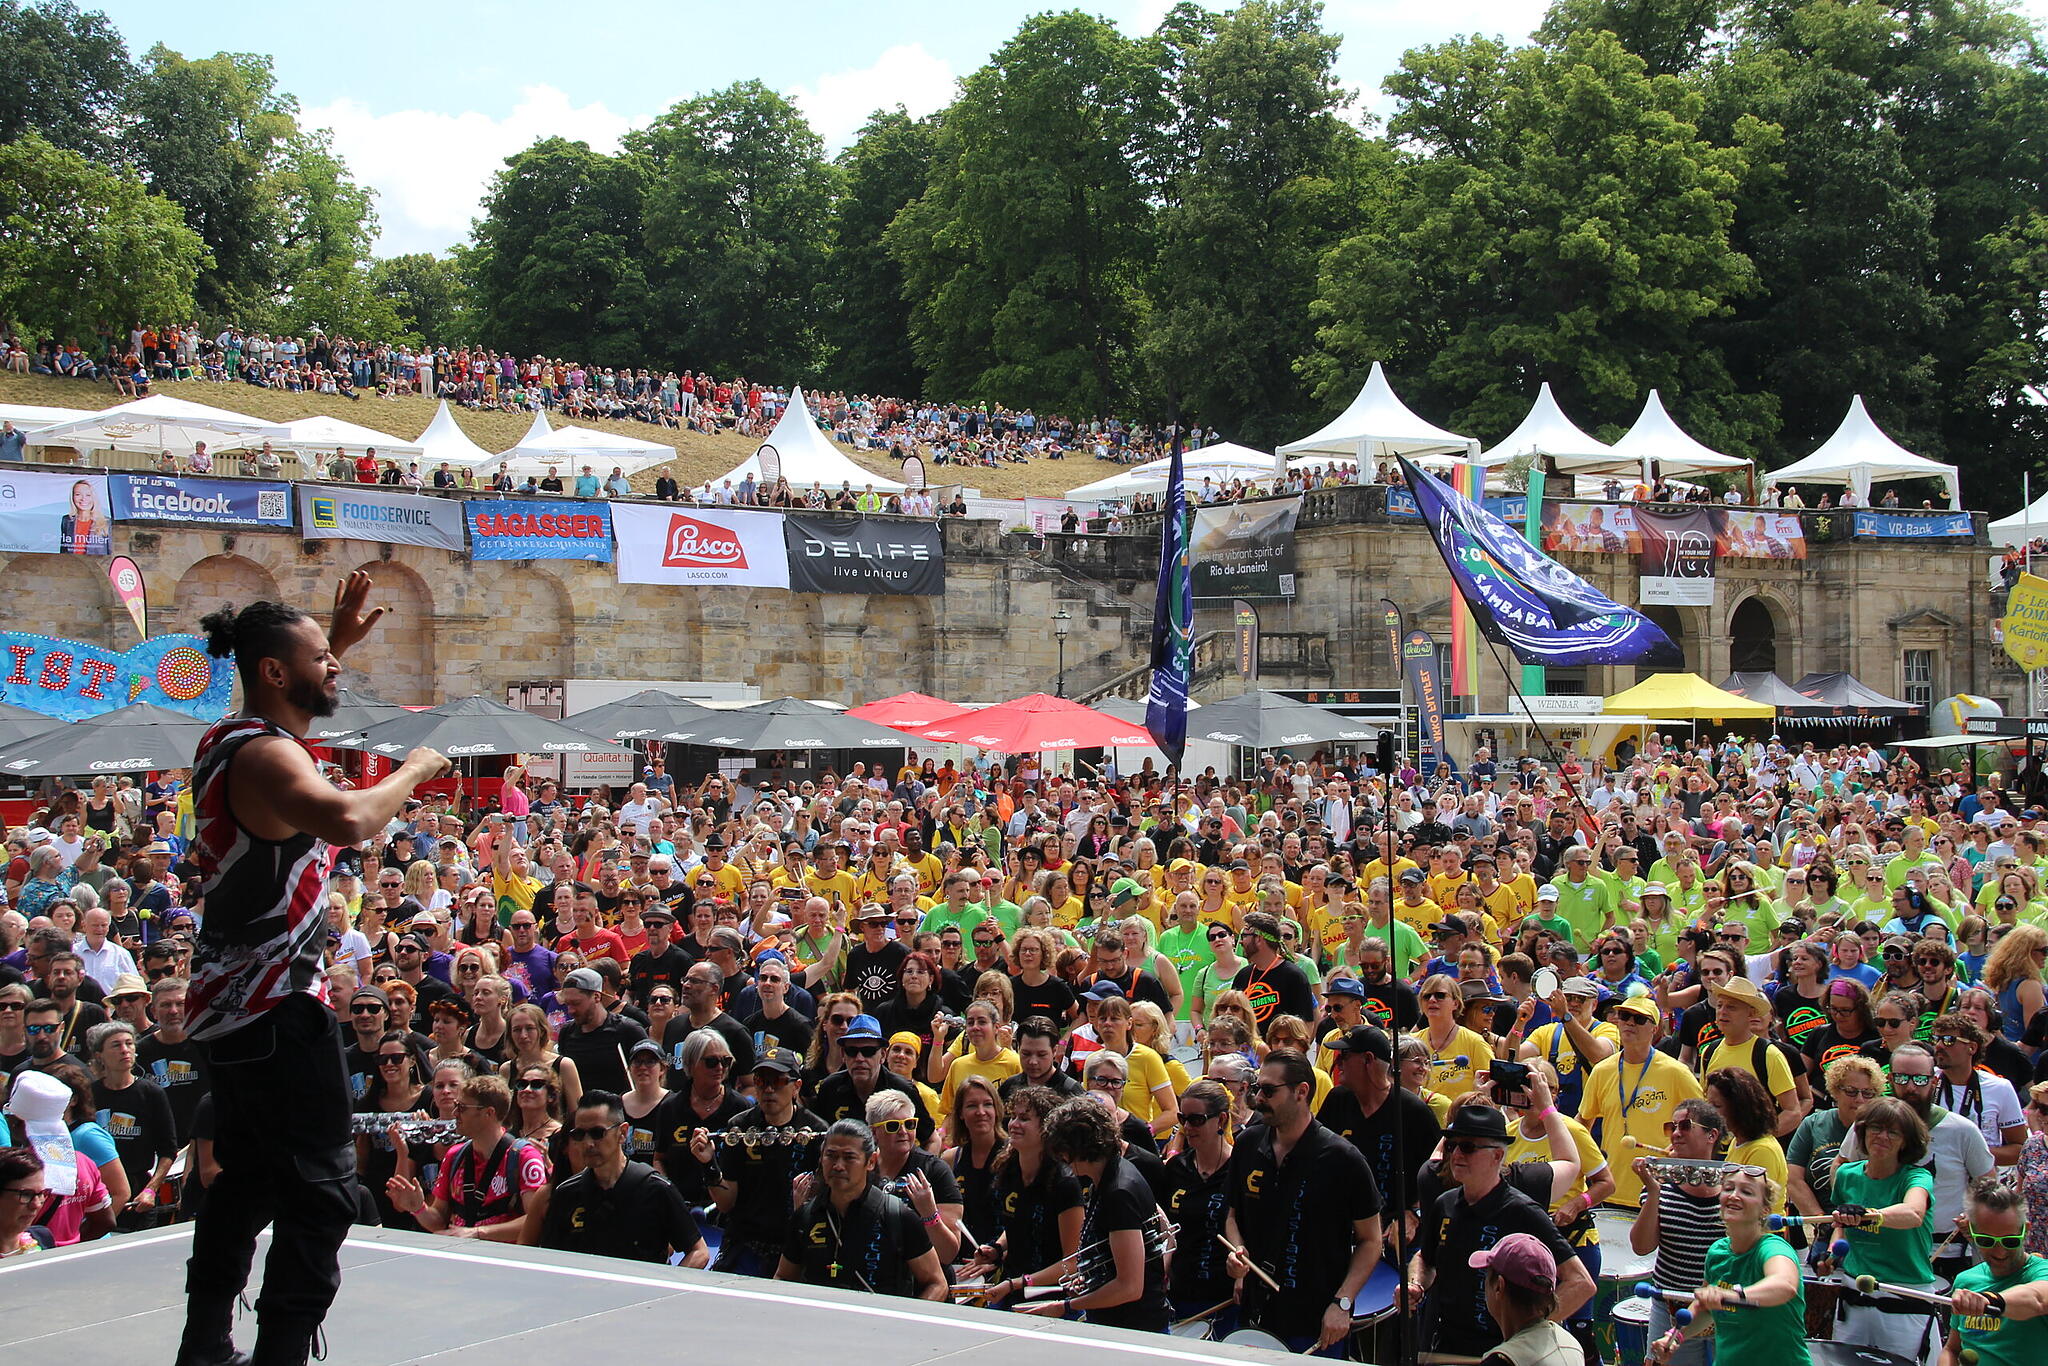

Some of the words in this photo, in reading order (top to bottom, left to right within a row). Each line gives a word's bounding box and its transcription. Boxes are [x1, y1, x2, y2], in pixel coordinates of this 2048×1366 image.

[129, 476, 147, 485] Find
[343, 503, 431, 525] FOODSERVICE
[475, 513, 604, 538] SAGASSER
[1888, 522, 1933, 535] VR-Bank
[669, 524, 741, 563] Lasco
[805, 539, 930, 561] DELIFE
[1226, 548, 1253, 560] vibrant
[1255, 545, 1273, 560] spirit
[1275, 544, 1284, 556] of
[833, 566, 858, 577] live
[864, 568, 909, 581] unique
[1210, 565, 1223, 576] Rio
[1224, 564, 1235, 574] de
[1237, 560, 1268, 574] Janeiro!
[1537, 700, 1579, 709] WEINBAR
[448, 743, 497, 754] Coca-Cola
[542, 742, 590, 750] Coca-Cola
[785, 738, 827, 748] Coca-Cola
[1040, 738, 1079, 748] Coca-Cola
[90, 757, 154, 770] Coca-Cola
